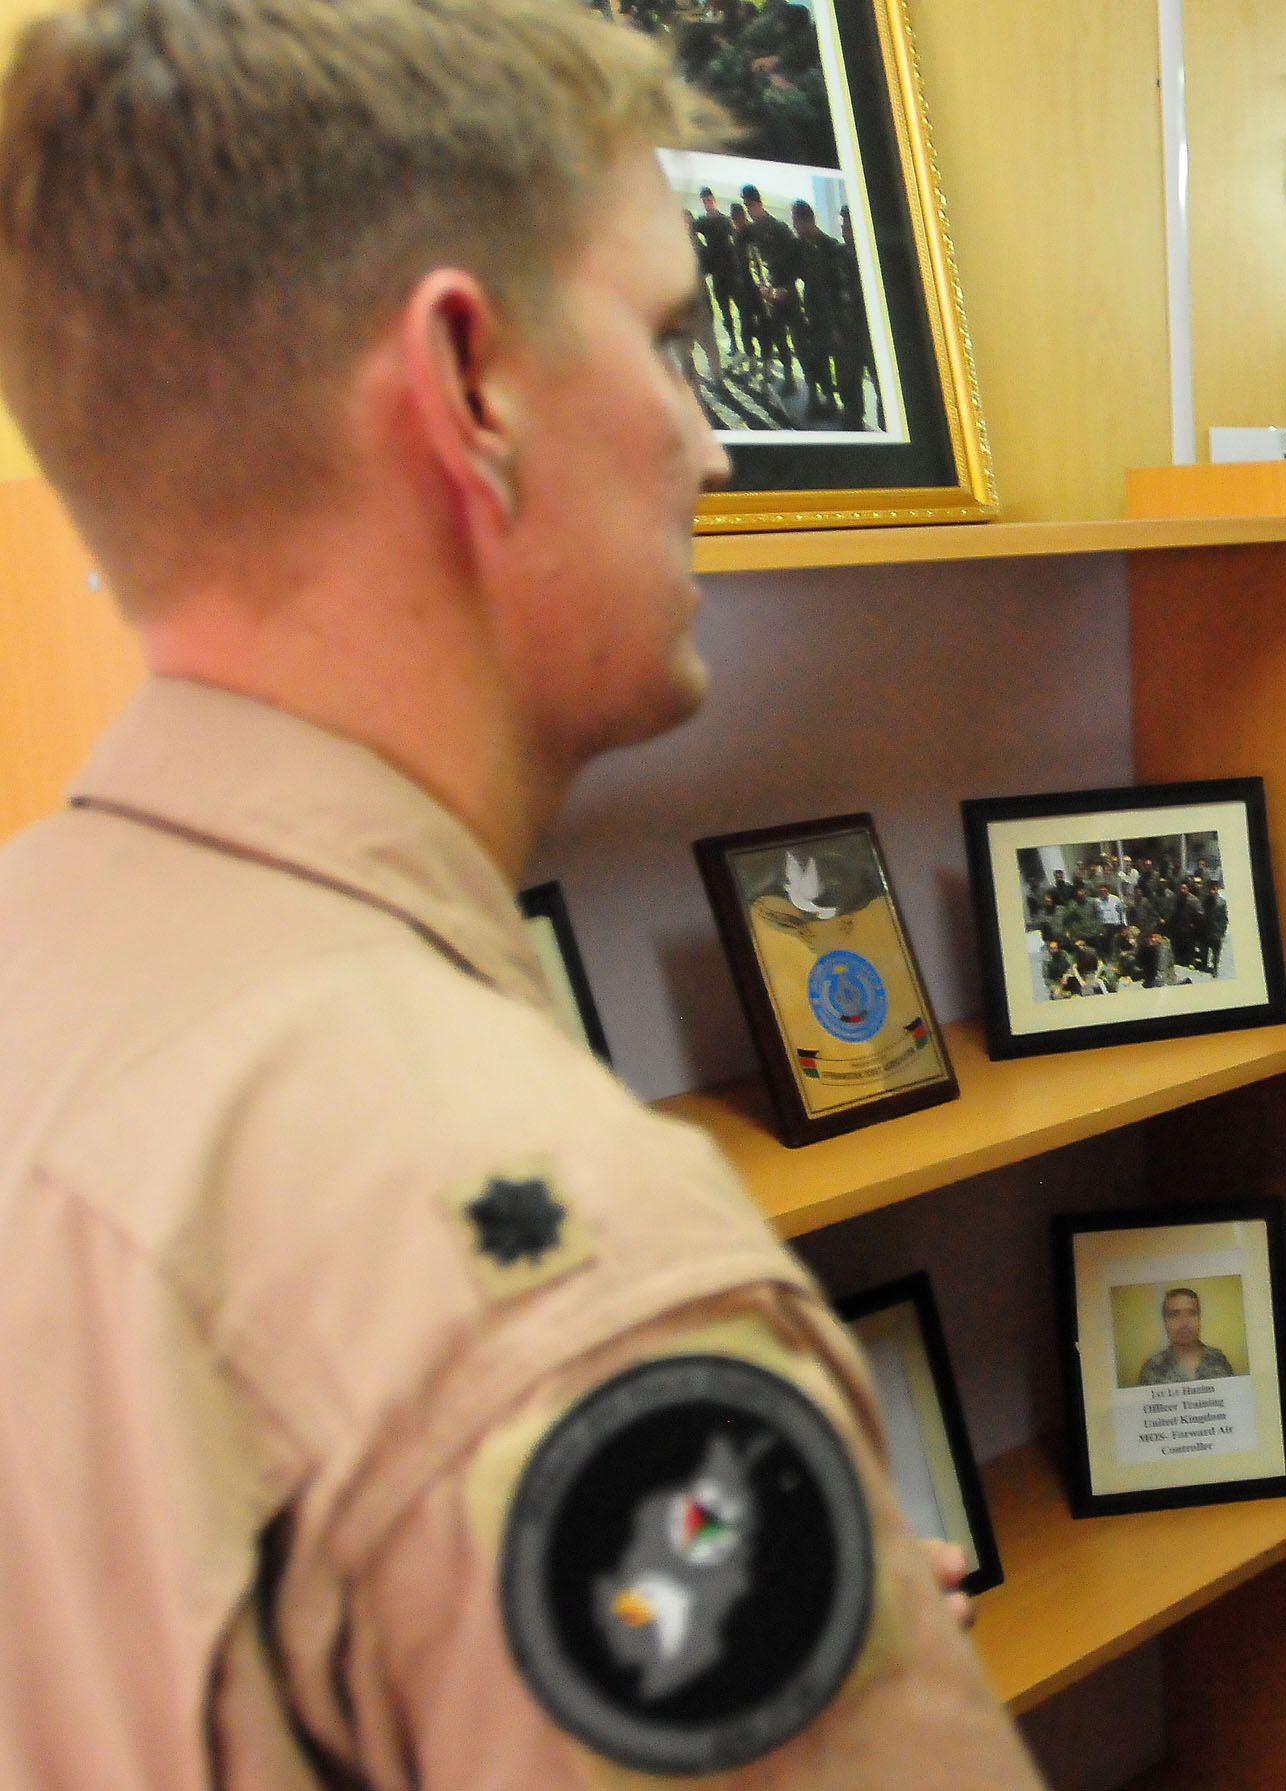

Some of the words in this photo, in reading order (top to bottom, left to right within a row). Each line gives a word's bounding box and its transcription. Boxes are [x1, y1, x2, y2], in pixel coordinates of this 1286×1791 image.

[1143, 1403, 1178, 1413] Officer
[1182, 1399, 1224, 1410] Training
[1143, 1417, 1178, 1428] United
[1180, 1412, 1227, 1425] Kingdom
[1171, 1426, 1216, 1440] Forward
[1218, 1426, 1233, 1434] Air
[1161, 1442, 1213, 1456] Controller
